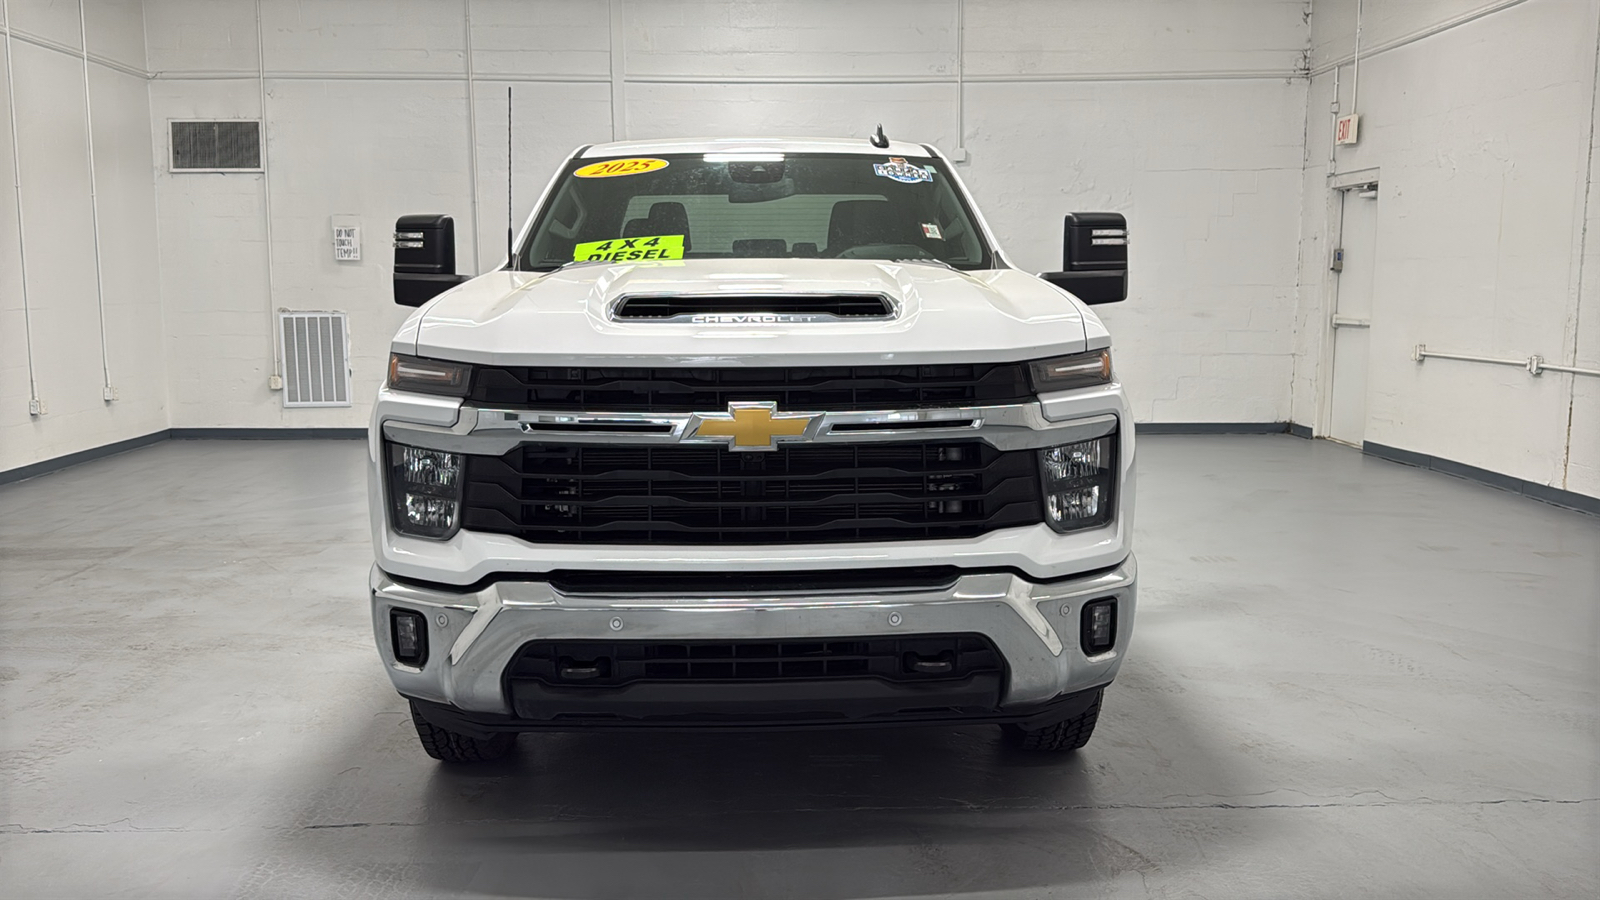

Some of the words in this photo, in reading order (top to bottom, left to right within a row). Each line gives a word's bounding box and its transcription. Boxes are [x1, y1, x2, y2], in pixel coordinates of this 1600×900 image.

[1338, 119, 1351, 141] EXIT
[589, 160, 656, 176] 2025
[336, 228, 343, 238] DO
[344, 228, 356, 239] NOT
[336, 238, 352, 248] TOUCH
[588, 248, 670, 263] DIESEL
